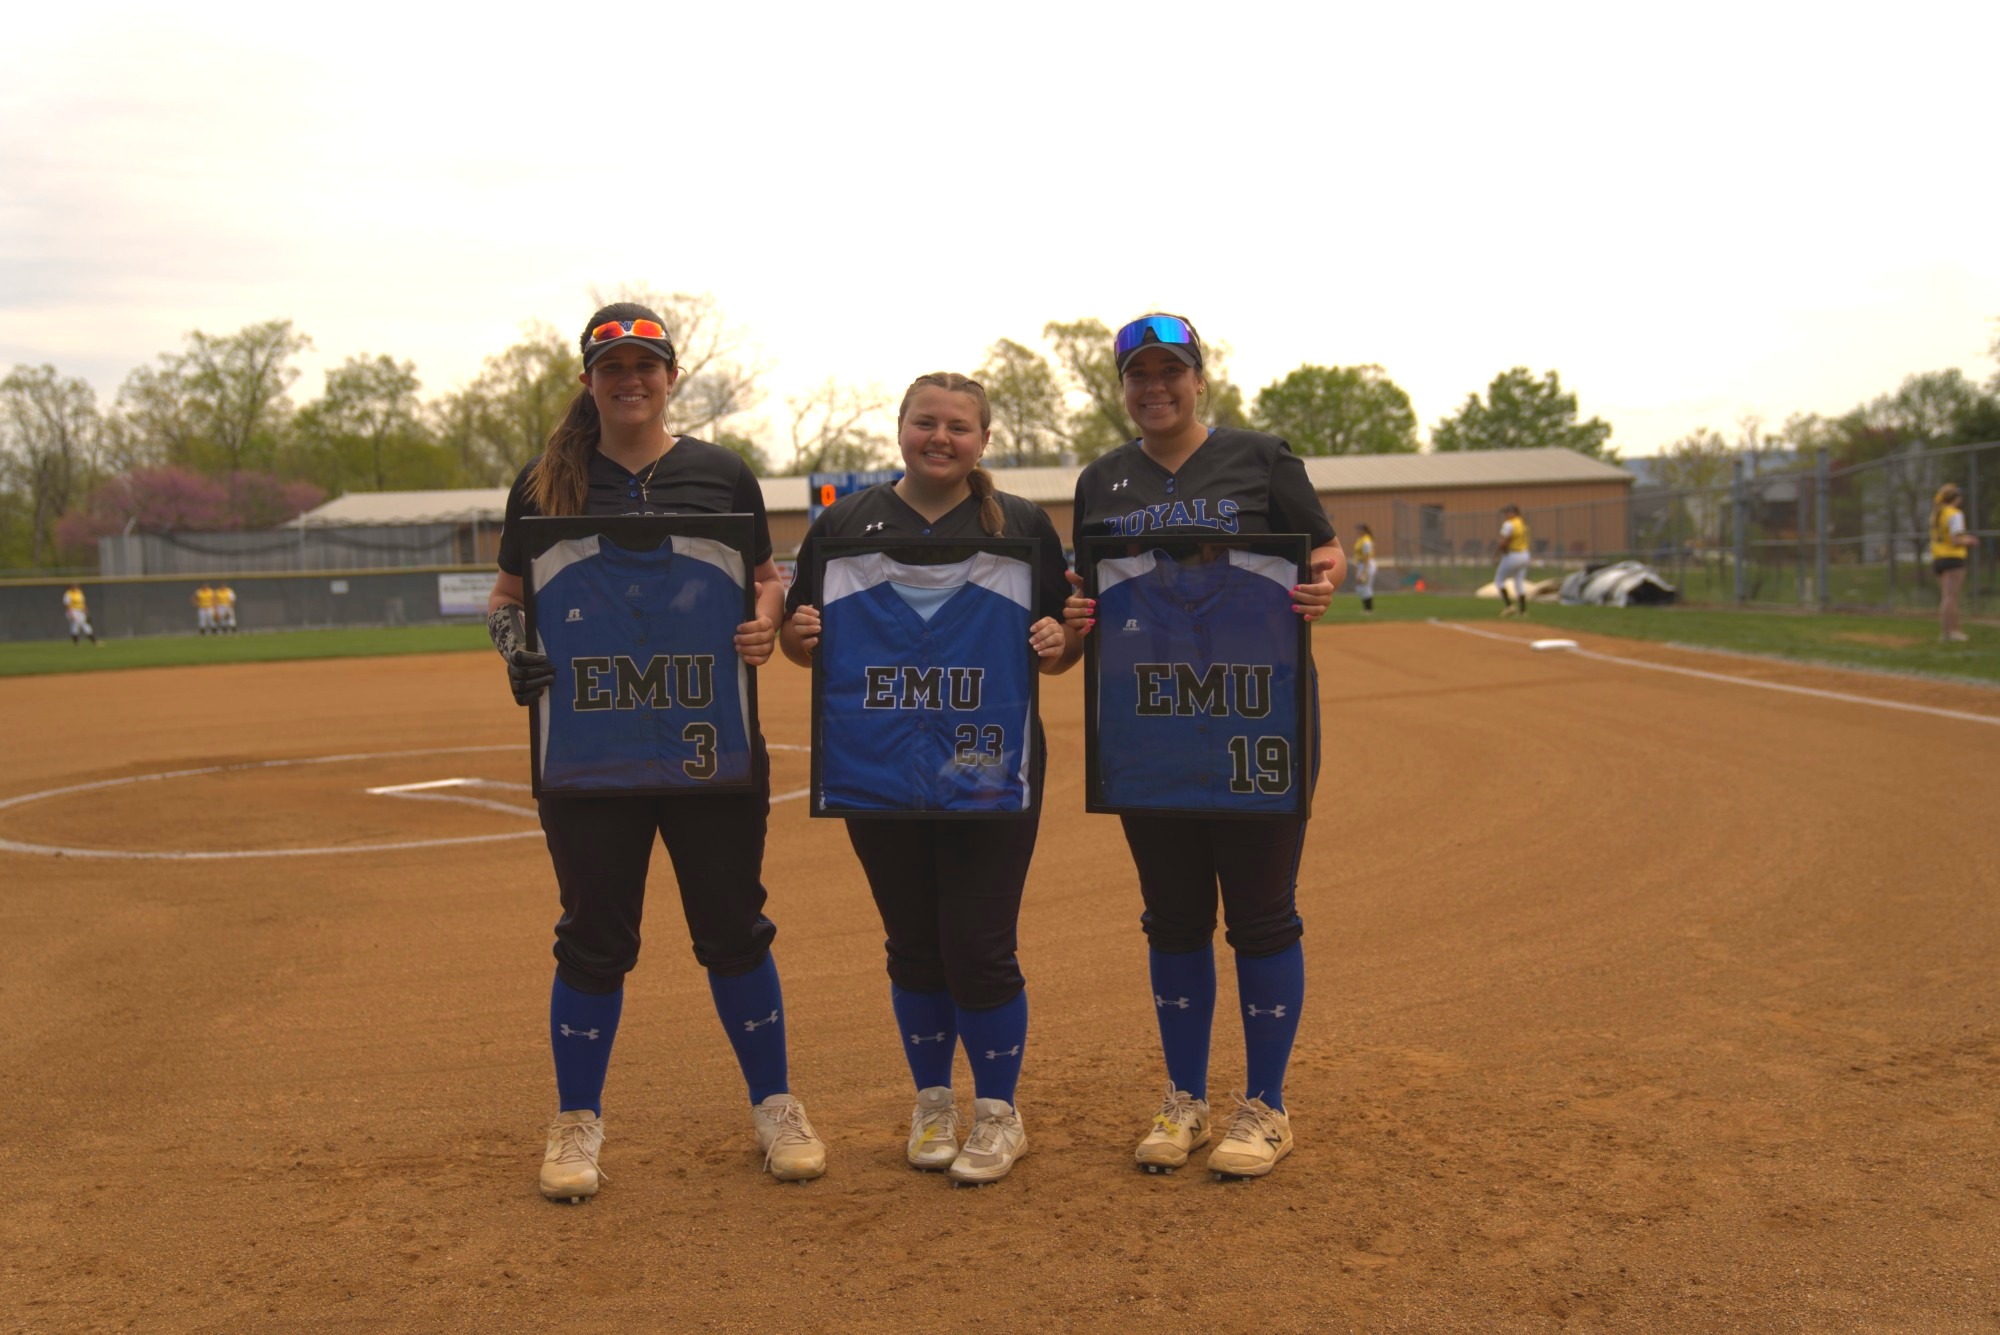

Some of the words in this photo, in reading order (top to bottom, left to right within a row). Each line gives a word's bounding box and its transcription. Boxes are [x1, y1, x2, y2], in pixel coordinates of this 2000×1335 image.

[571, 654, 715, 711] EMU
[863, 666, 985, 711] EMU
[1134, 663, 1273, 719] EMU
[682, 722, 717, 779] 3
[954, 724, 1004, 767] 23
[1228, 736, 1291, 795] 19
